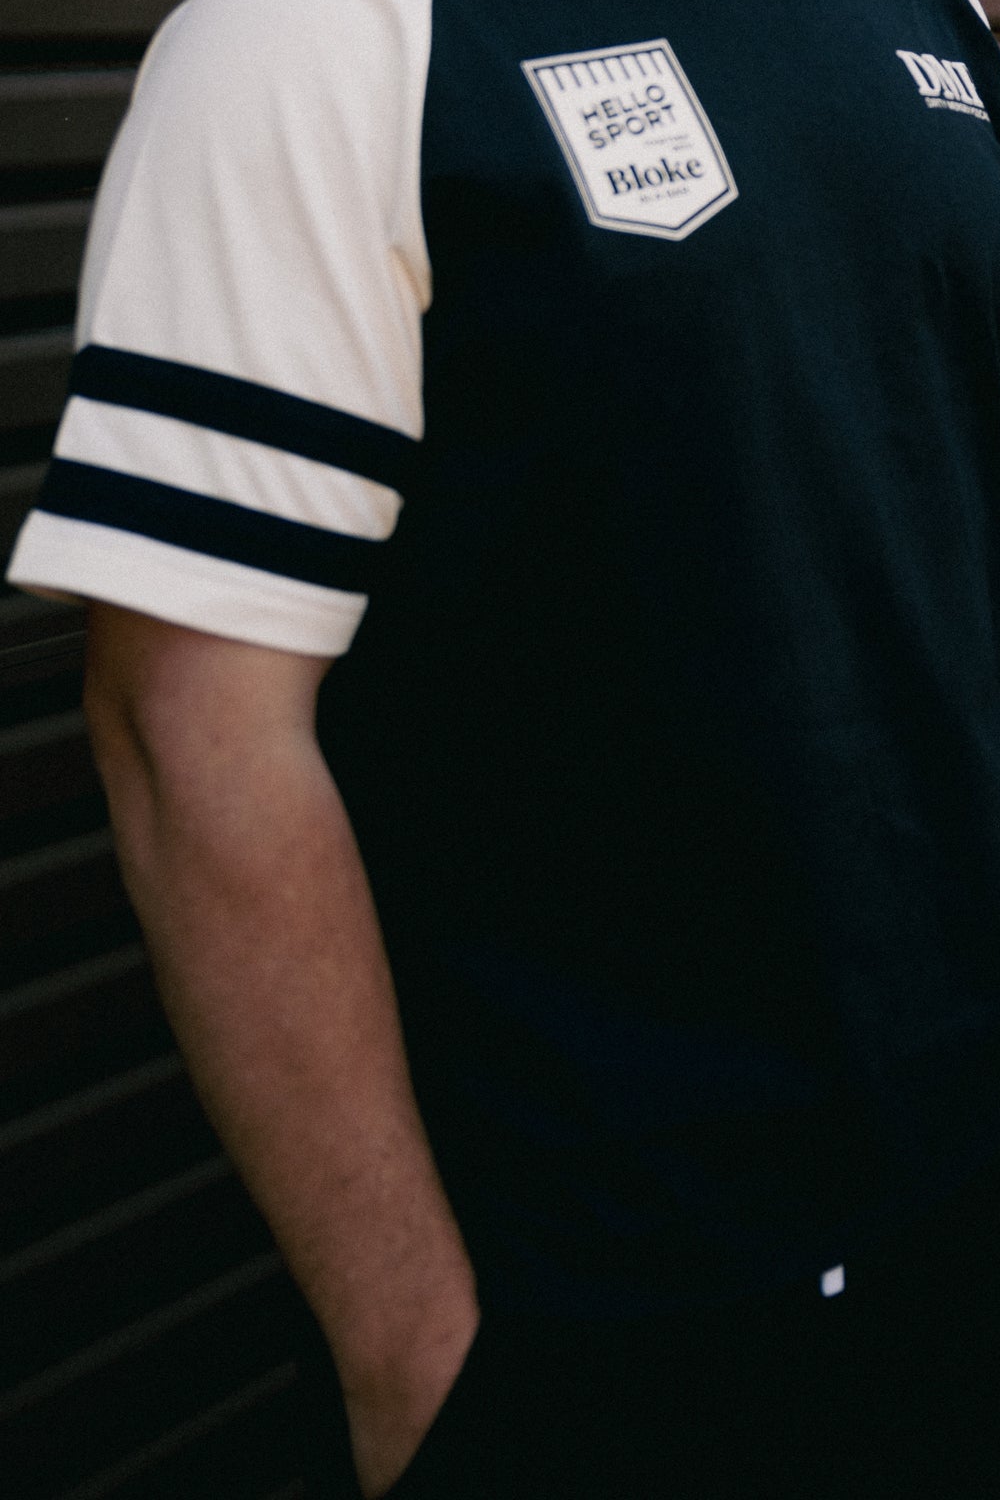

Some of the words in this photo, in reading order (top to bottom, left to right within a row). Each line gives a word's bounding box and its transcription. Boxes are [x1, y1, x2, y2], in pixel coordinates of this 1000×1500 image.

[582, 84, 666, 127] HELLO
[588, 104, 677, 150] SPORT
[604, 157, 705, 195] Bloke
